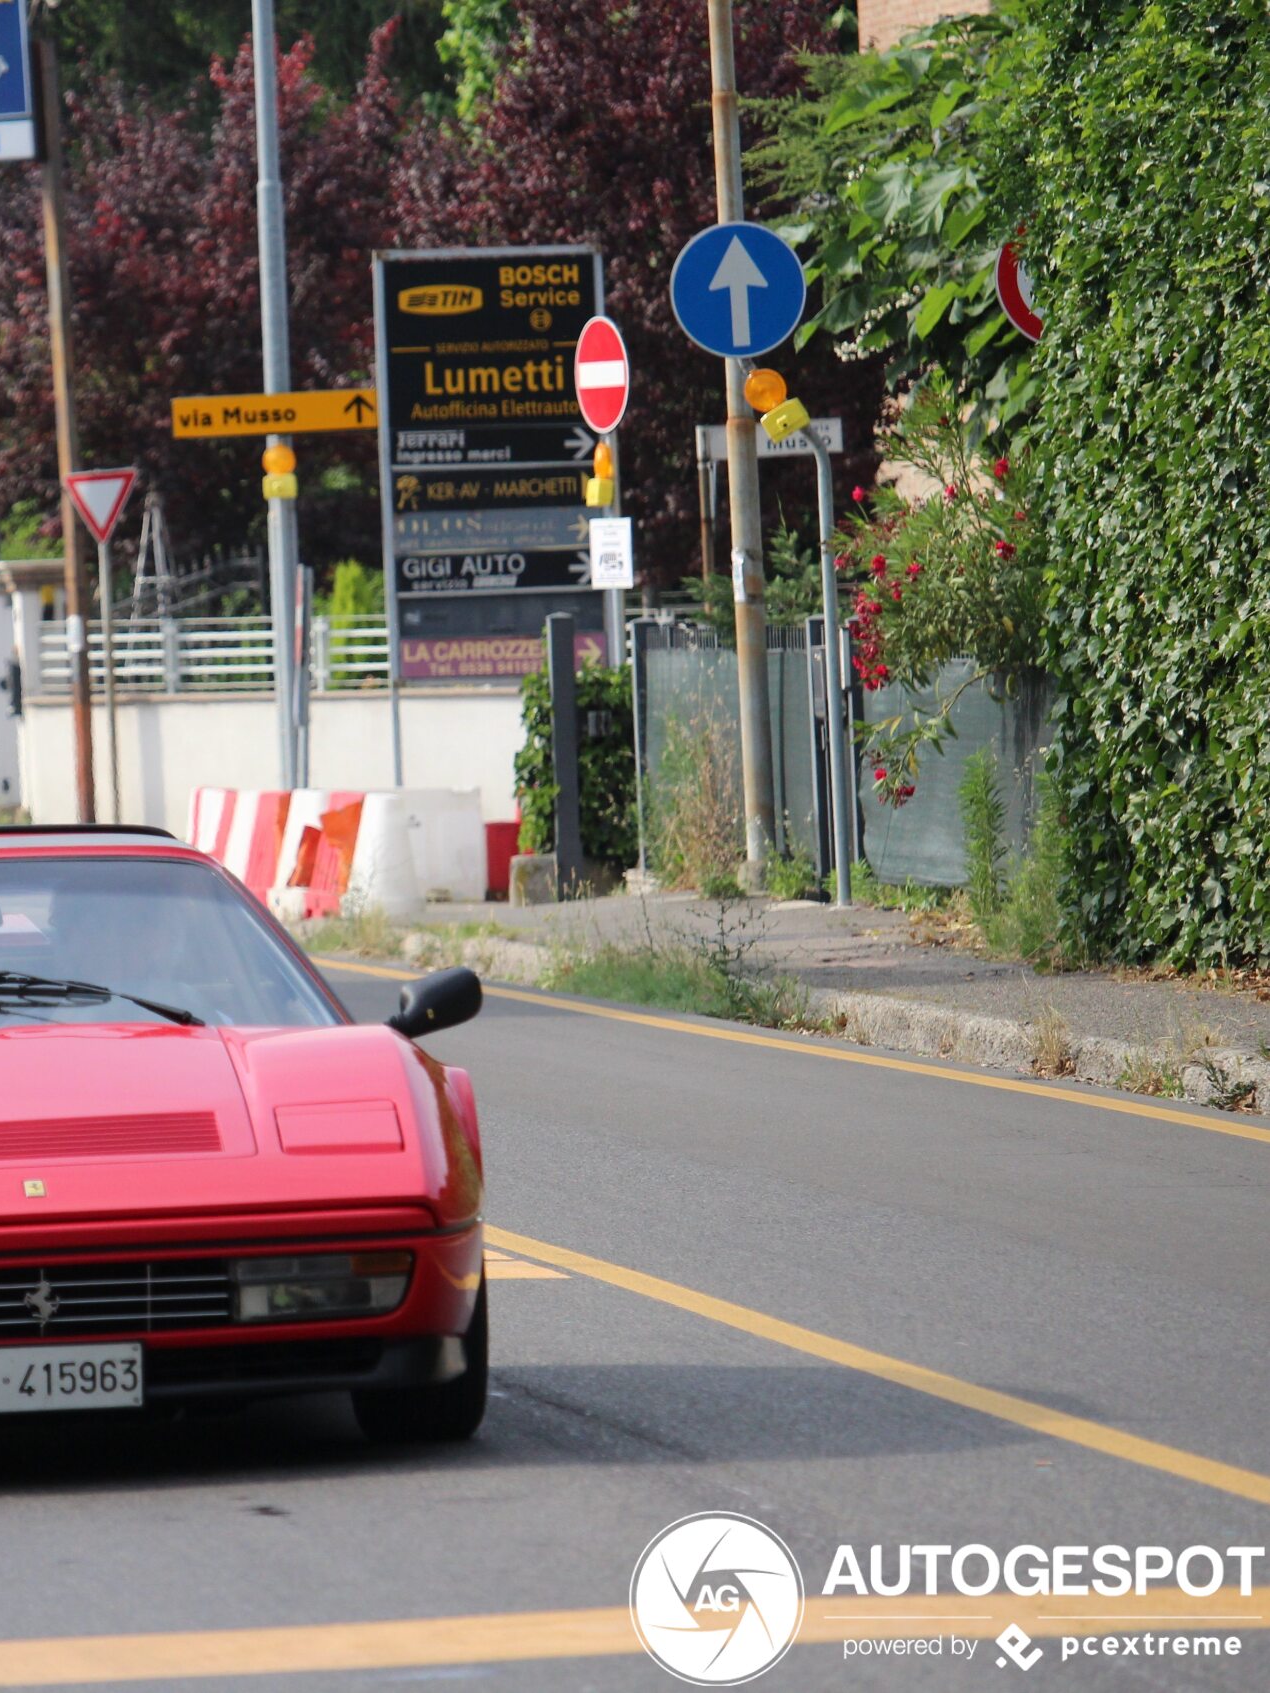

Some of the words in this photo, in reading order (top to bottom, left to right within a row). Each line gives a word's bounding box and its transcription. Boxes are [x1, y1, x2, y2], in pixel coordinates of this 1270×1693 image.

[499, 264, 579, 286] BOSCH
[441, 289, 474, 307] TIM
[499, 288, 580, 308] Service
[424, 355, 565, 396] Lumetti
[180, 409, 213, 428] via
[222, 406, 297, 425] Musso
[411, 401, 498, 420] Autofficina
[501, 399, 581, 416] Elettrauto
[397, 430, 466, 448] Ferrari
[767, 435, 831, 451] muso
[467, 445, 511, 462] merci
[493, 476, 577, 498] MARCHETTI
[402, 557, 452, 580] GIGI
[460, 552, 526, 577] AUTO
[402, 641, 430, 663] LA
[432, 637, 547, 662] CARROZZE
[18, 1358, 139, 1397] 415963
